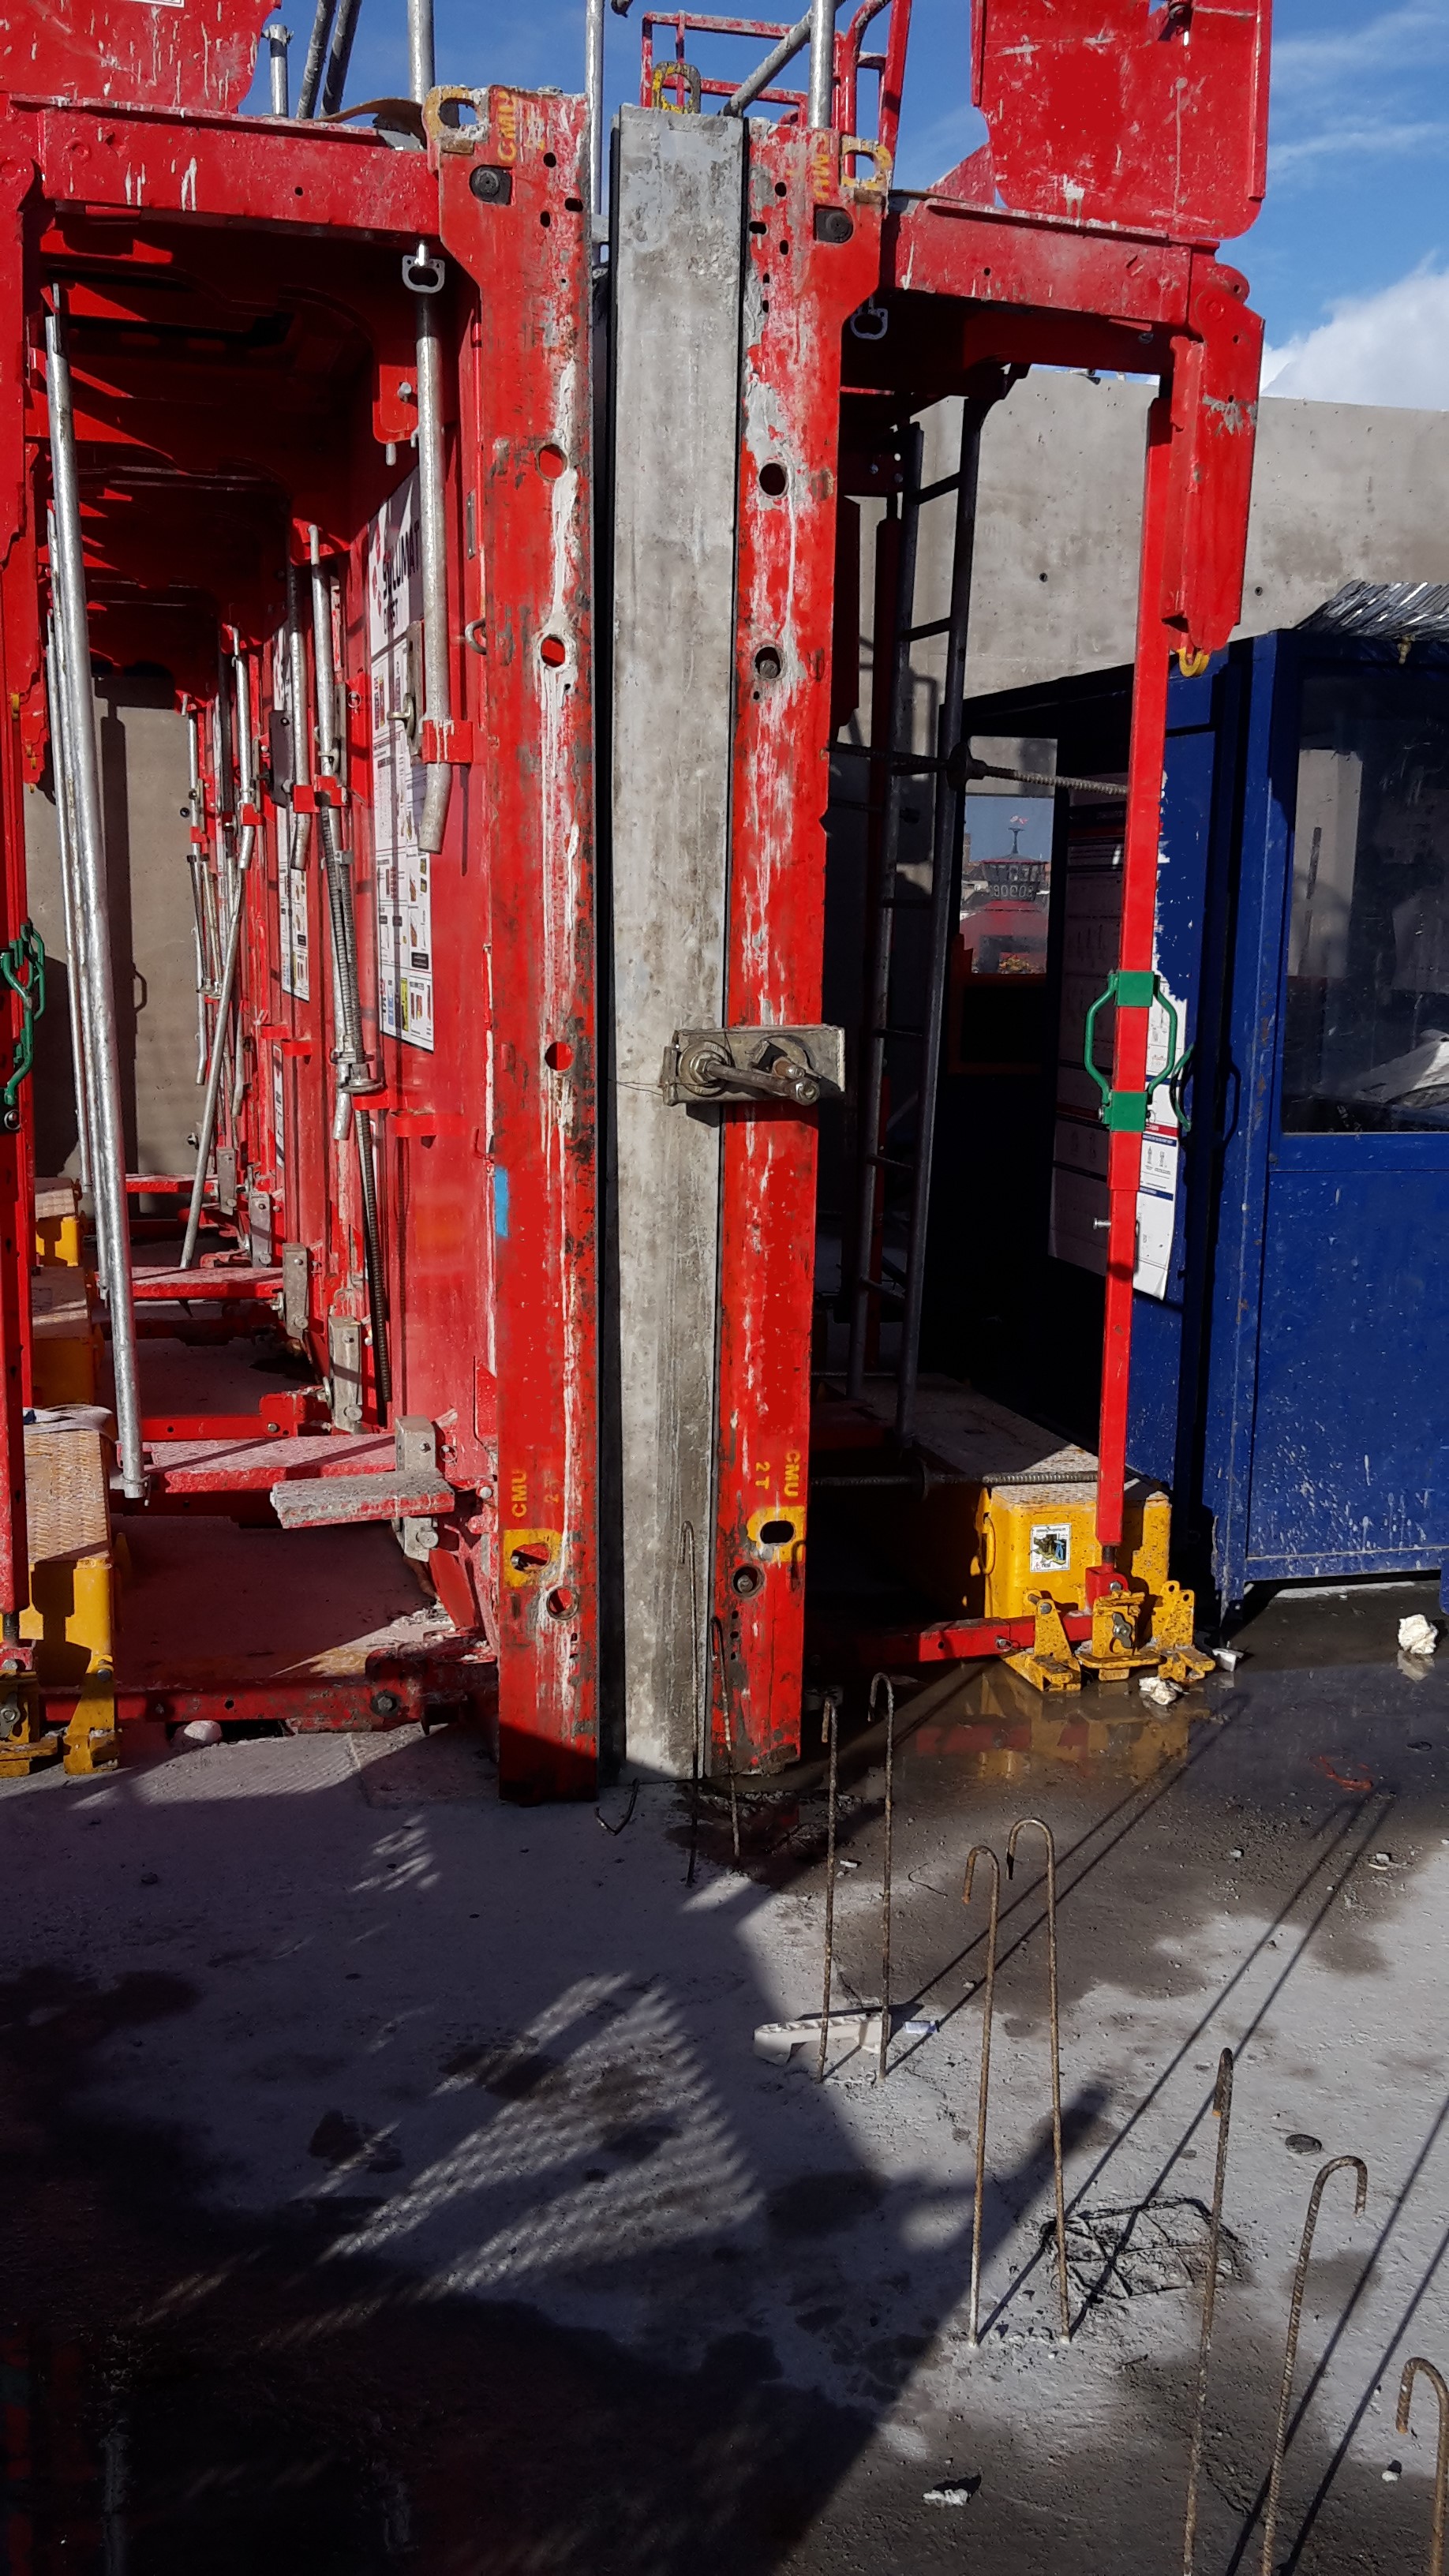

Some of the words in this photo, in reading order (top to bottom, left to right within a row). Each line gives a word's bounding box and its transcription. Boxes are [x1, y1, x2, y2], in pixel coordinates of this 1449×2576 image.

[498, 92, 517, 161] CMU
[510, 1467, 528, 1518] CMU
[784, 1449, 801, 1497] CMU
